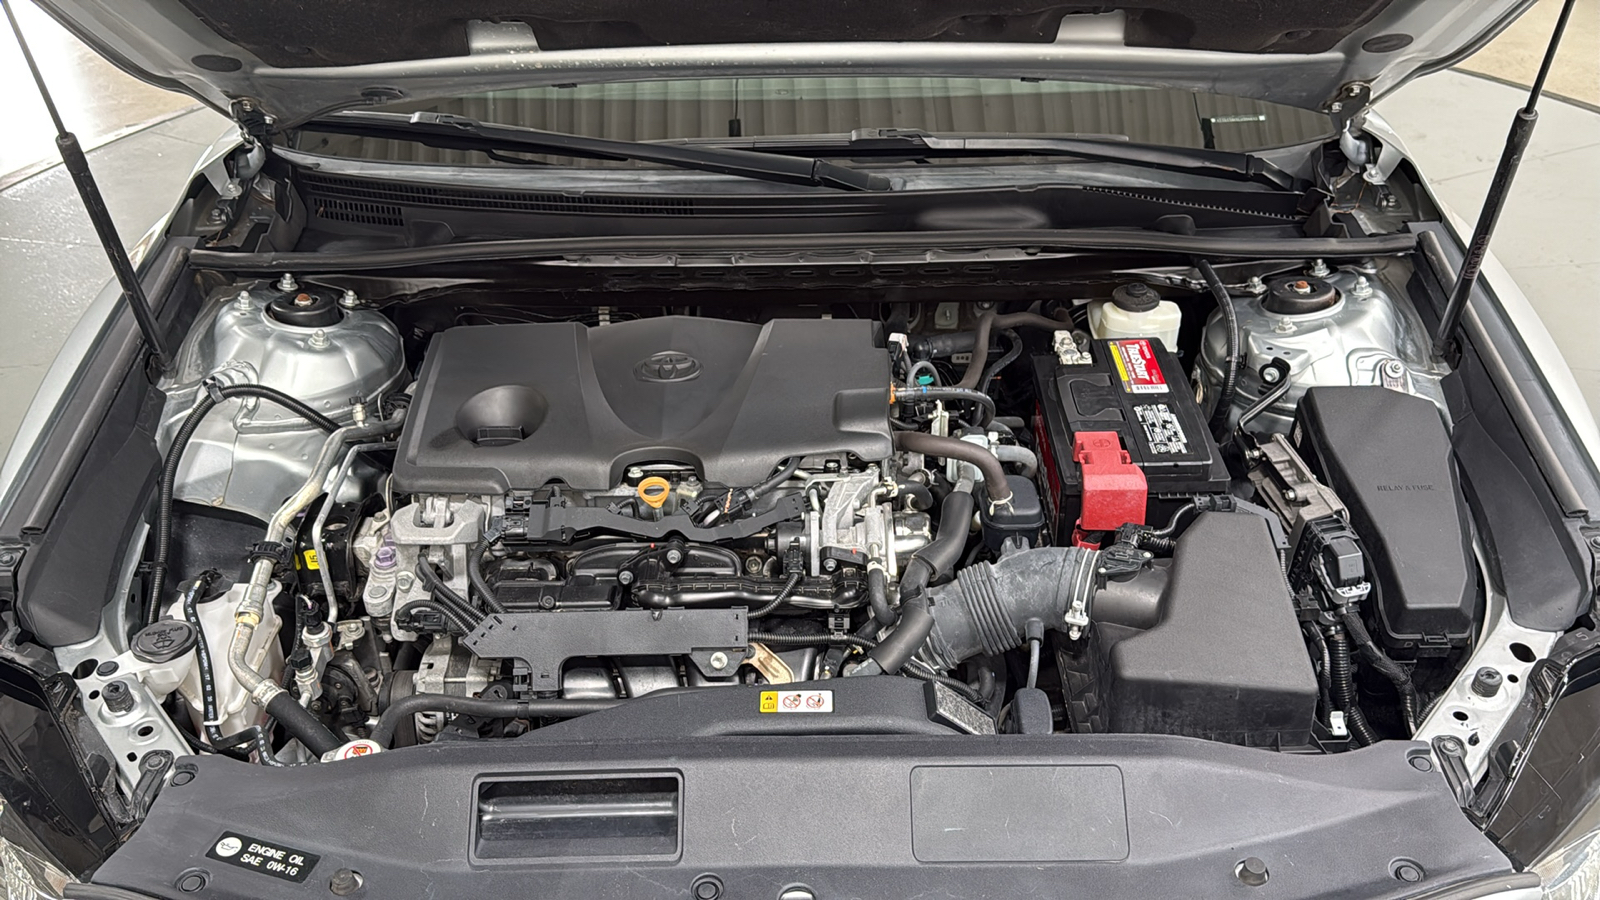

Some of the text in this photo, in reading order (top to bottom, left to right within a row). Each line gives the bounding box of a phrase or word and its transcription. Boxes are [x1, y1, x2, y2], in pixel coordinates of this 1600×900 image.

[240, 854, 299, 875] SAE 0W-16
[248, 843, 305, 866] ENGINE OIL
